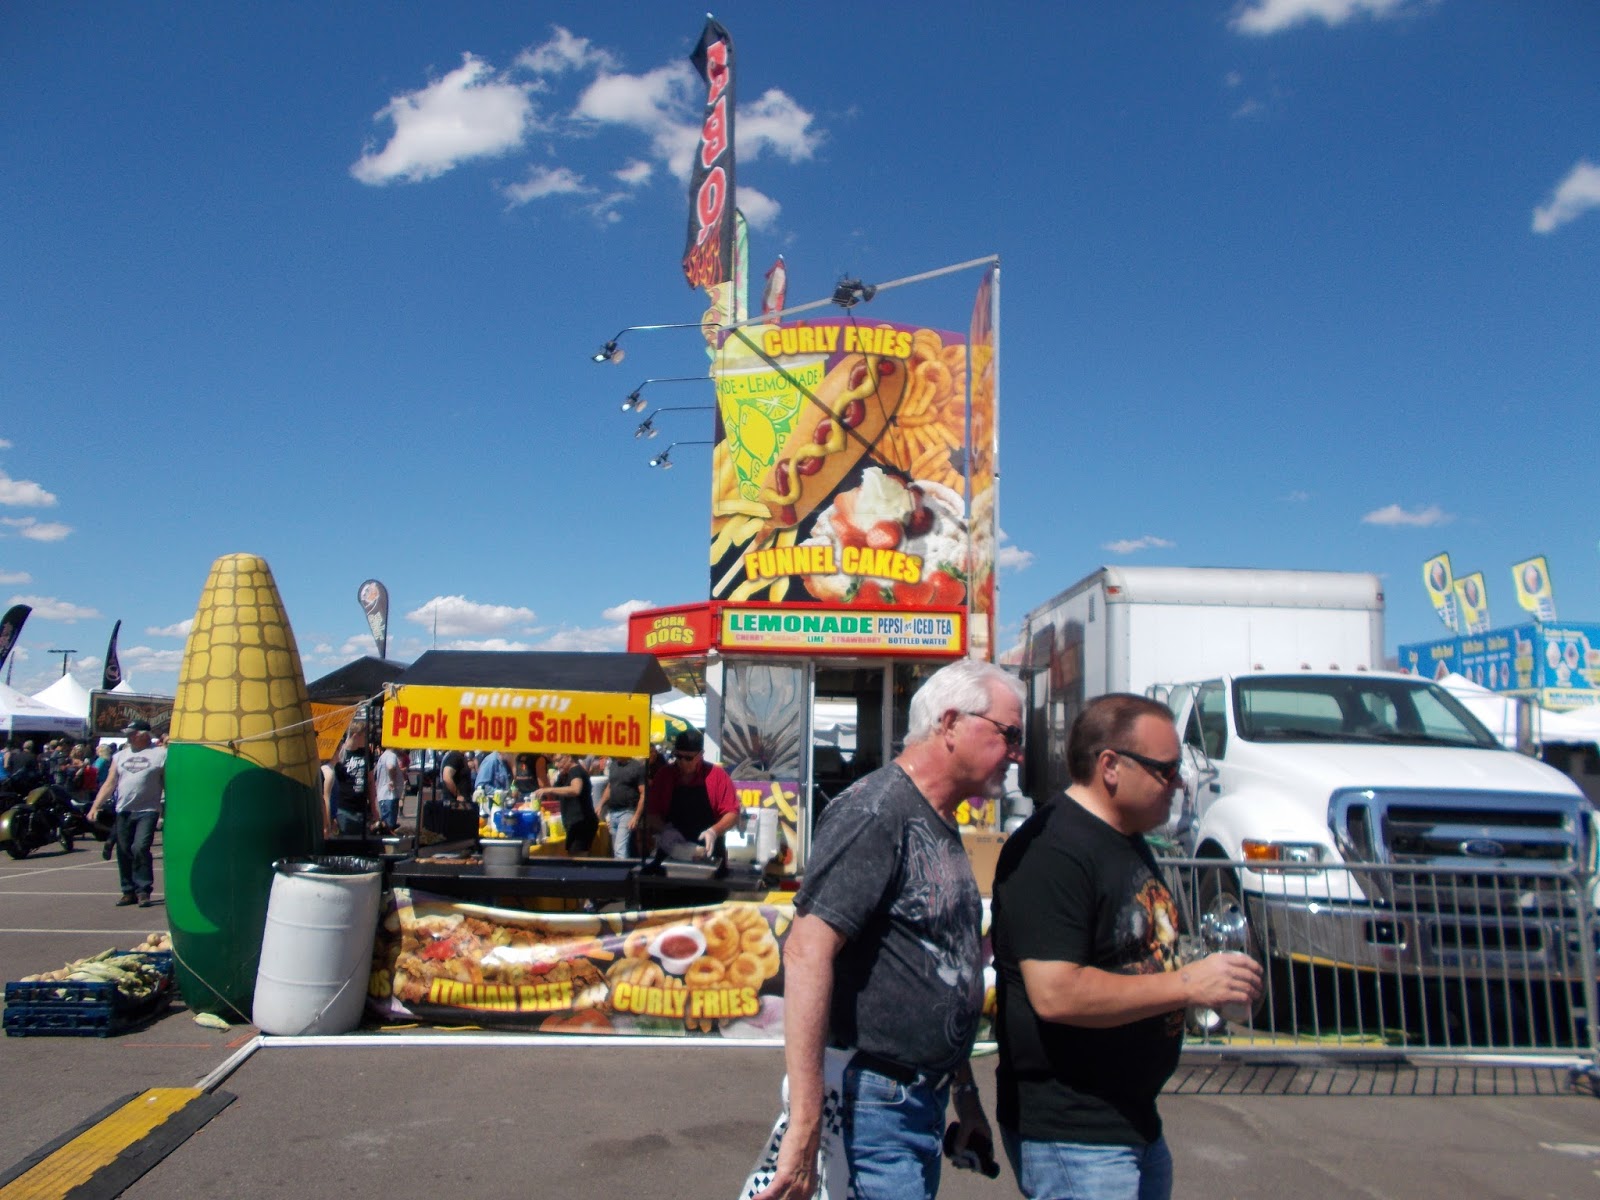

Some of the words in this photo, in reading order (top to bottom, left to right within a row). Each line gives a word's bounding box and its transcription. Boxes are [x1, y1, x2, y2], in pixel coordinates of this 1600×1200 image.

[764, 326, 840, 357] CURLY
[843, 326, 913, 359] FRIES
[745, 546, 836, 582] FUNNEL
[841, 546, 923, 584] CAKES
[653, 616, 686, 630] CORN
[730, 614, 873, 634] LEMONADE
[877, 617, 902, 635] PEPSI
[913, 618, 934, 635] ICED
[936, 619, 952, 635] TEA
[645, 627, 694, 648] DOGS
[831, 636, 882, 644] STRAWBERRY
[888, 637, 920, 645] BOTTLED
[459, 691, 572, 712] Butterfly
[392, 706, 448, 739] Pork
[459, 708, 517, 747] Chop
[528, 711, 641, 746] Sandwich
[429, 978, 516, 1011] ITALIAN
[520, 980, 573, 1011] BEEF
[613, 982, 687, 1017] CURLY
[691, 987, 760, 1018] FRIES
